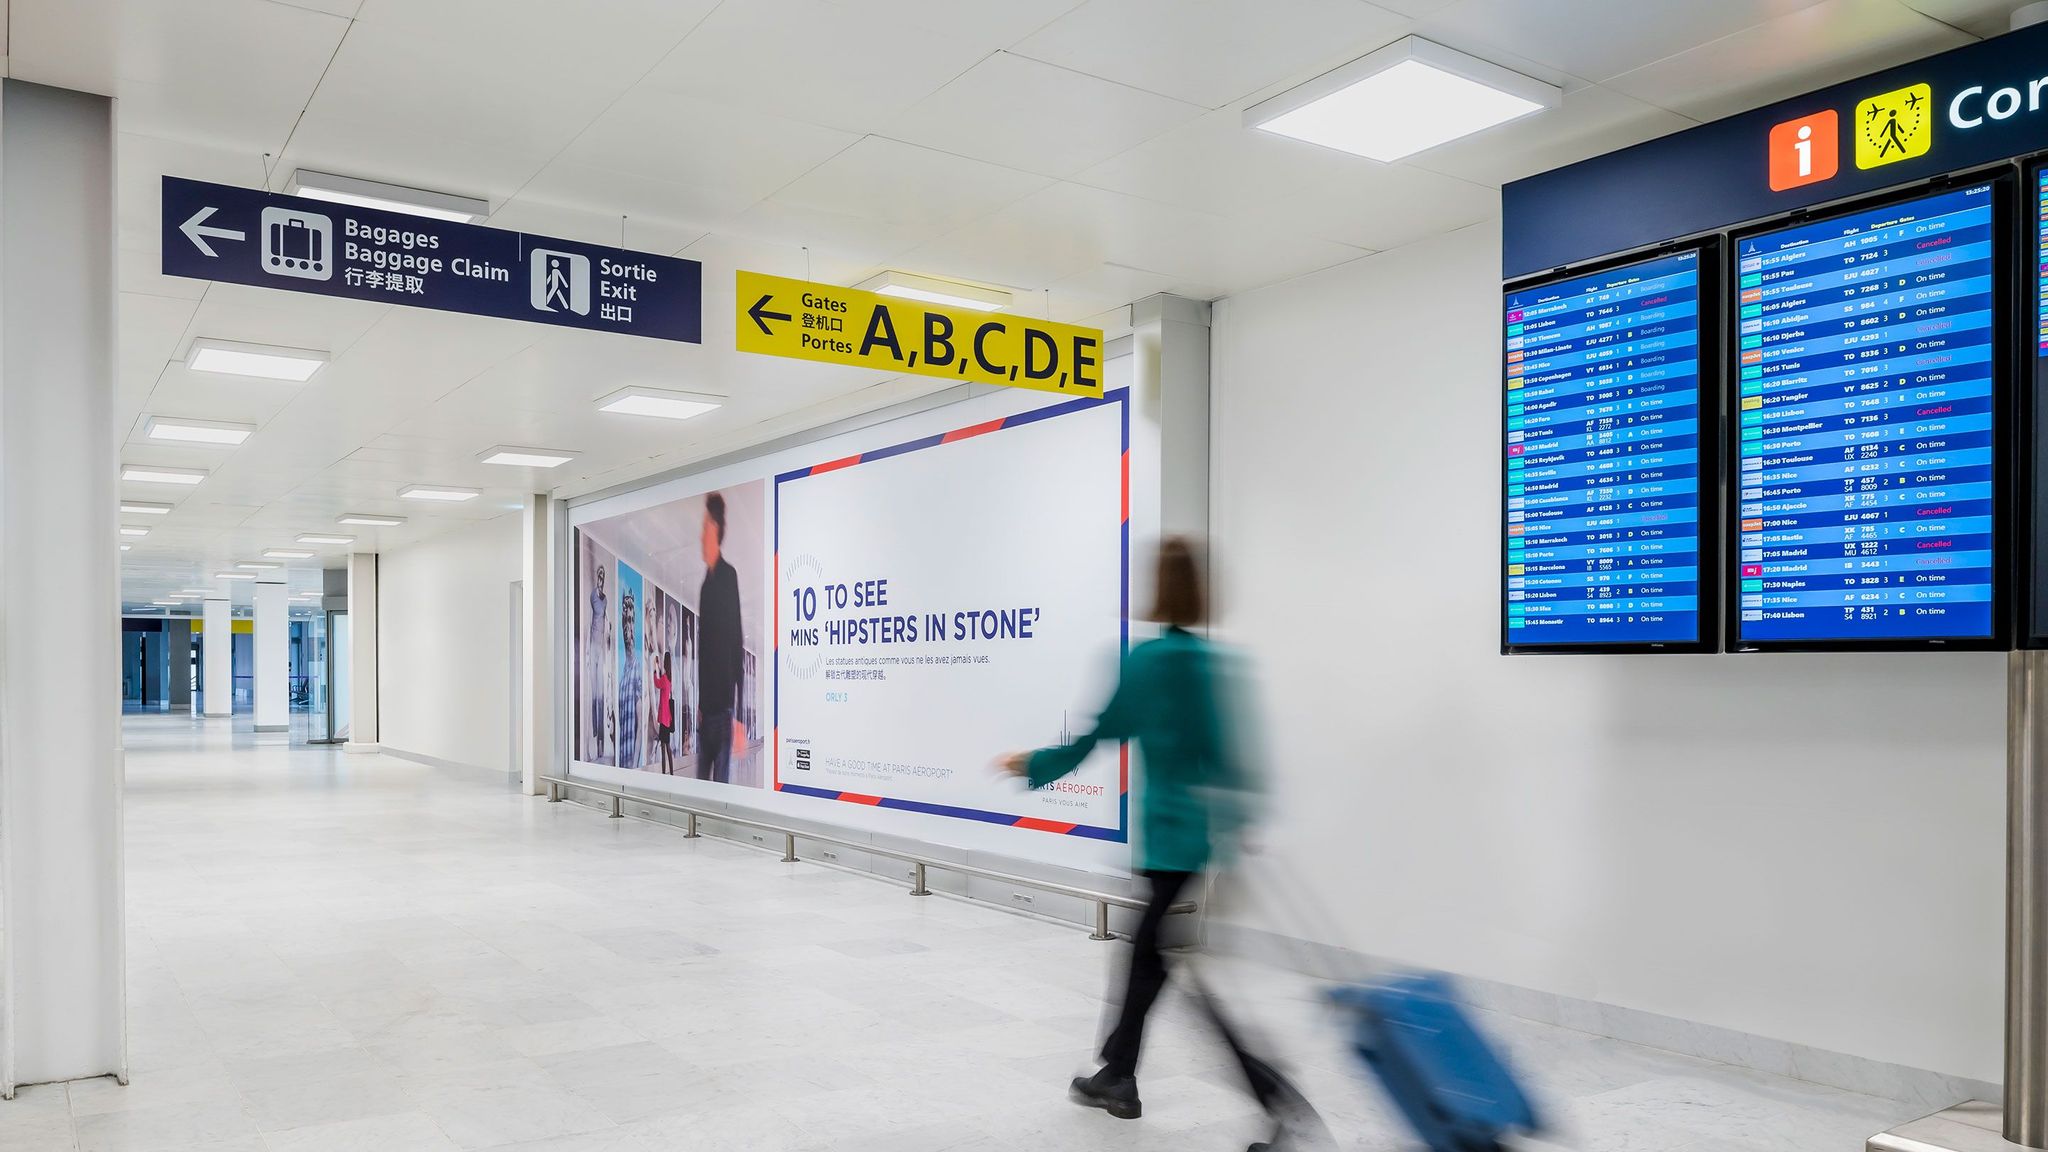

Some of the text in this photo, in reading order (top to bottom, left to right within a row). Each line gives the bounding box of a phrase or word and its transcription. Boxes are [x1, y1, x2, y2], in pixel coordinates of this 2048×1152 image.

[345, 218, 439, 250] Bagages
[345, 241, 510, 283] Baggage Claim
[1762, 272, 1780, 281] 15:55
[1916, 237, 1951, 249] Cancelled
[1781, 252, 1806, 261] Algiers
[600, 258, 658, 284] Sortie
[344, 267, 425, 295] 行李提取
[1781, 282, 1813, 292] Toulouse
[600, 280, 637, 301] Exit
[801, 292, 848, 314] Gates
[1762, 303, 1780, 311] 16:05
[1781, 299, 1806, 308] Algiers
[600, 302, 633, 323] 出口
[801, 313, 843, 332] 登机口
[801, 334, 852, 354] Portes
[1763, 334, 1780, 342] 16:10
[1781, 331, 1805, 340] Djerba
[859, 304, 1098, 389] A,B,C,D,E
[1763, 365, 1780, 373] 16:15
[1781, 362, 1800, 370] Tunis
[1640, 385, 1665, 393] Boarding
[1781, 393, 1808, 401] Tangier
[1781, 422, 1823, 432] Montpellier
[1917, 405, 1952, 416] Cancelled
[1917, 506, 1952, 515] Cancelled
[1917, 540, 1952, 549] Cancelled
[1782, 580, 1806, 588] Naples
[793, 586, 817, 622] 10
[825, 580, 888, 610] TO SEE
[926, 613, 946, 642] IN
[790, 628, 818, 646] MINS
[826, 654, 990, 667] Les statues antiques comme vous ne les avez jamais vues.
[826, 692, 848, 703] ORLY 3
[825, 758, 841, 768] HAVE
[842, 759, 847, 768] A
[847, 759, 865, 771] GOOD
[866, 761, 882, 772] TIME
[883, 763, 891, 772] AT
[892, 764, 911, 775] PARIS
[1056, 781, 1104, 796] AÉROPORT
